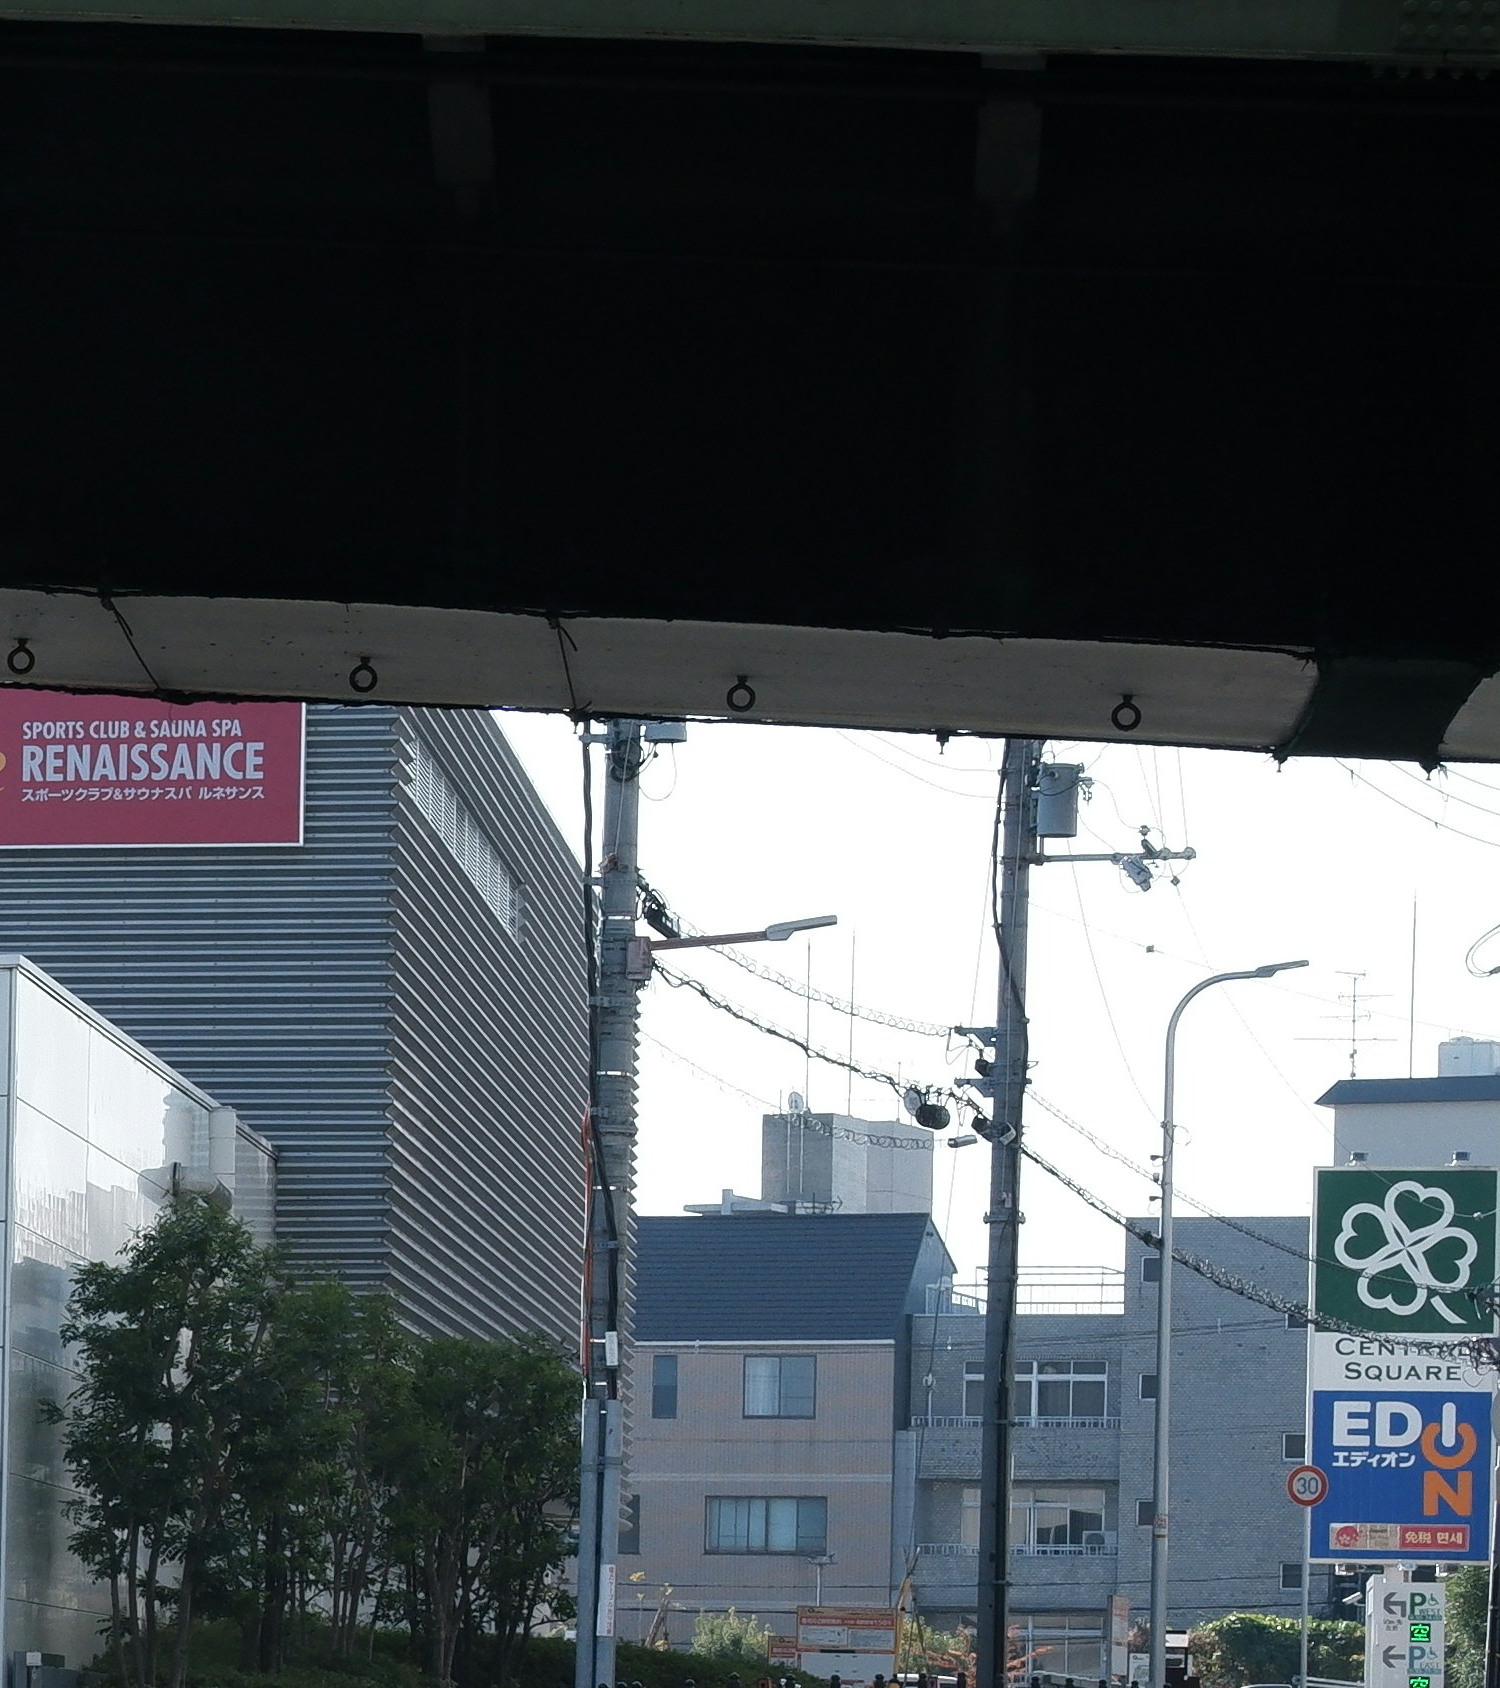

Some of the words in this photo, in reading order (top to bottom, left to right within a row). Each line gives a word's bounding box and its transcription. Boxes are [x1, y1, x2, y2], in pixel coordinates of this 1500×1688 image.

[22, 721, 84, 740] SPORTS
[89, 721, 130, 739] CLUB
[134, 721, 147, 738] &
[150, 719, 206, 738] SAUNA
[211, 719, 242, 738] SPA
[21, 741, 265, 782] RENAISSANCE
[198, 785, 266, 801] ルネサンス
[1344, 1362, 1462, 1382] SQUARE
[1332, 1452, 1416, 1468] エディオン
[1296, 1476, 1319, 1495] 30
[1405, 1531, 1432, 1544] 免税
[1410, 1624, 1430, 1642] 空
